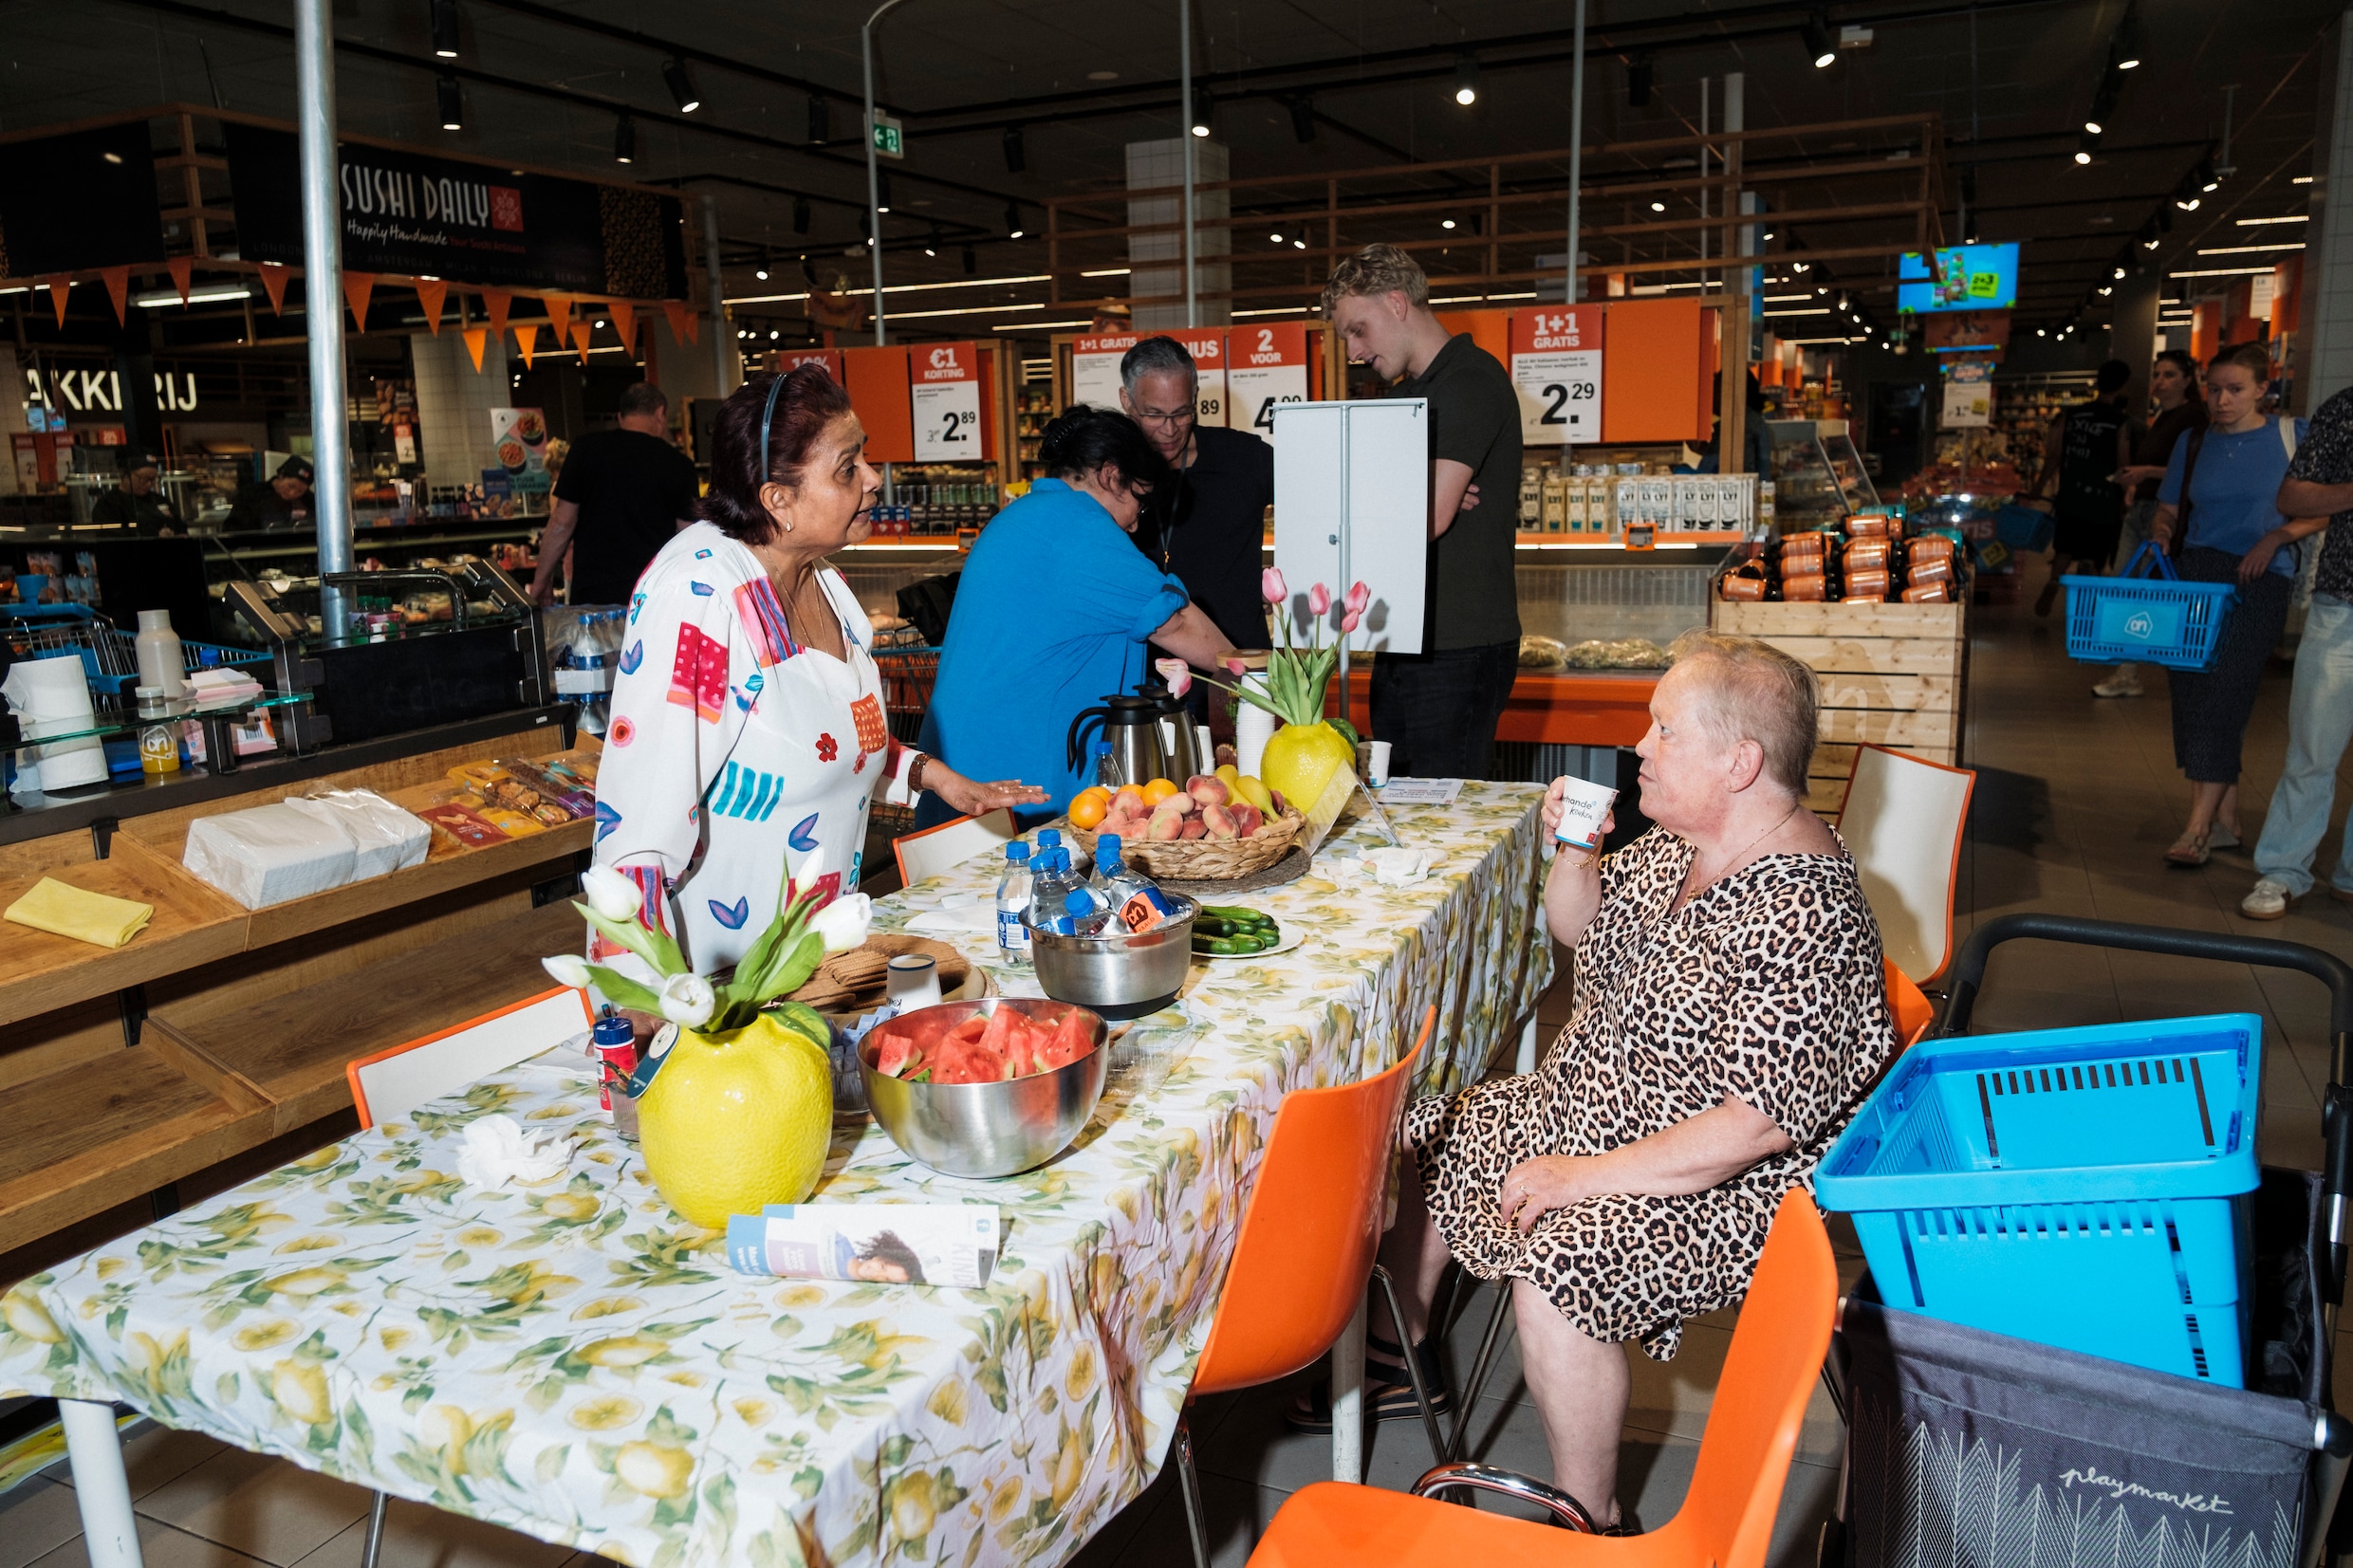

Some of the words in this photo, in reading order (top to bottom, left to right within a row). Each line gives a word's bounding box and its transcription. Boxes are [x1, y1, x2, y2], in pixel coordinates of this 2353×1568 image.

[341, 163, 417, 219] SUSHI
[421, 175, 490, 229] DAILY
[346, 217, 388, 246] Happily
[389, 220, 448, 248] Handmade
[1534, 312, 1580, 336] 1+1
[1080, 339, 1098, 350] 1+1
[1100, 337, 1138, 349] GRATIS
[1257, 328, 1273, 352] 2
[1533, 335, 1580, 349] GRATIS
[929, 347, 957, 369] €1
[1181, 340, 1219, 359] NUS
[1250, 352, 1282, 364] VOOR
[924, 368, 965, 380] KORTING
[1200, 399, 1219, 415] 89
[1562, 795, 1592, 810] rhande
[1139, 917, 1156, 932] TAALD
[2058, 1466, 2234, 1514] playmarket
